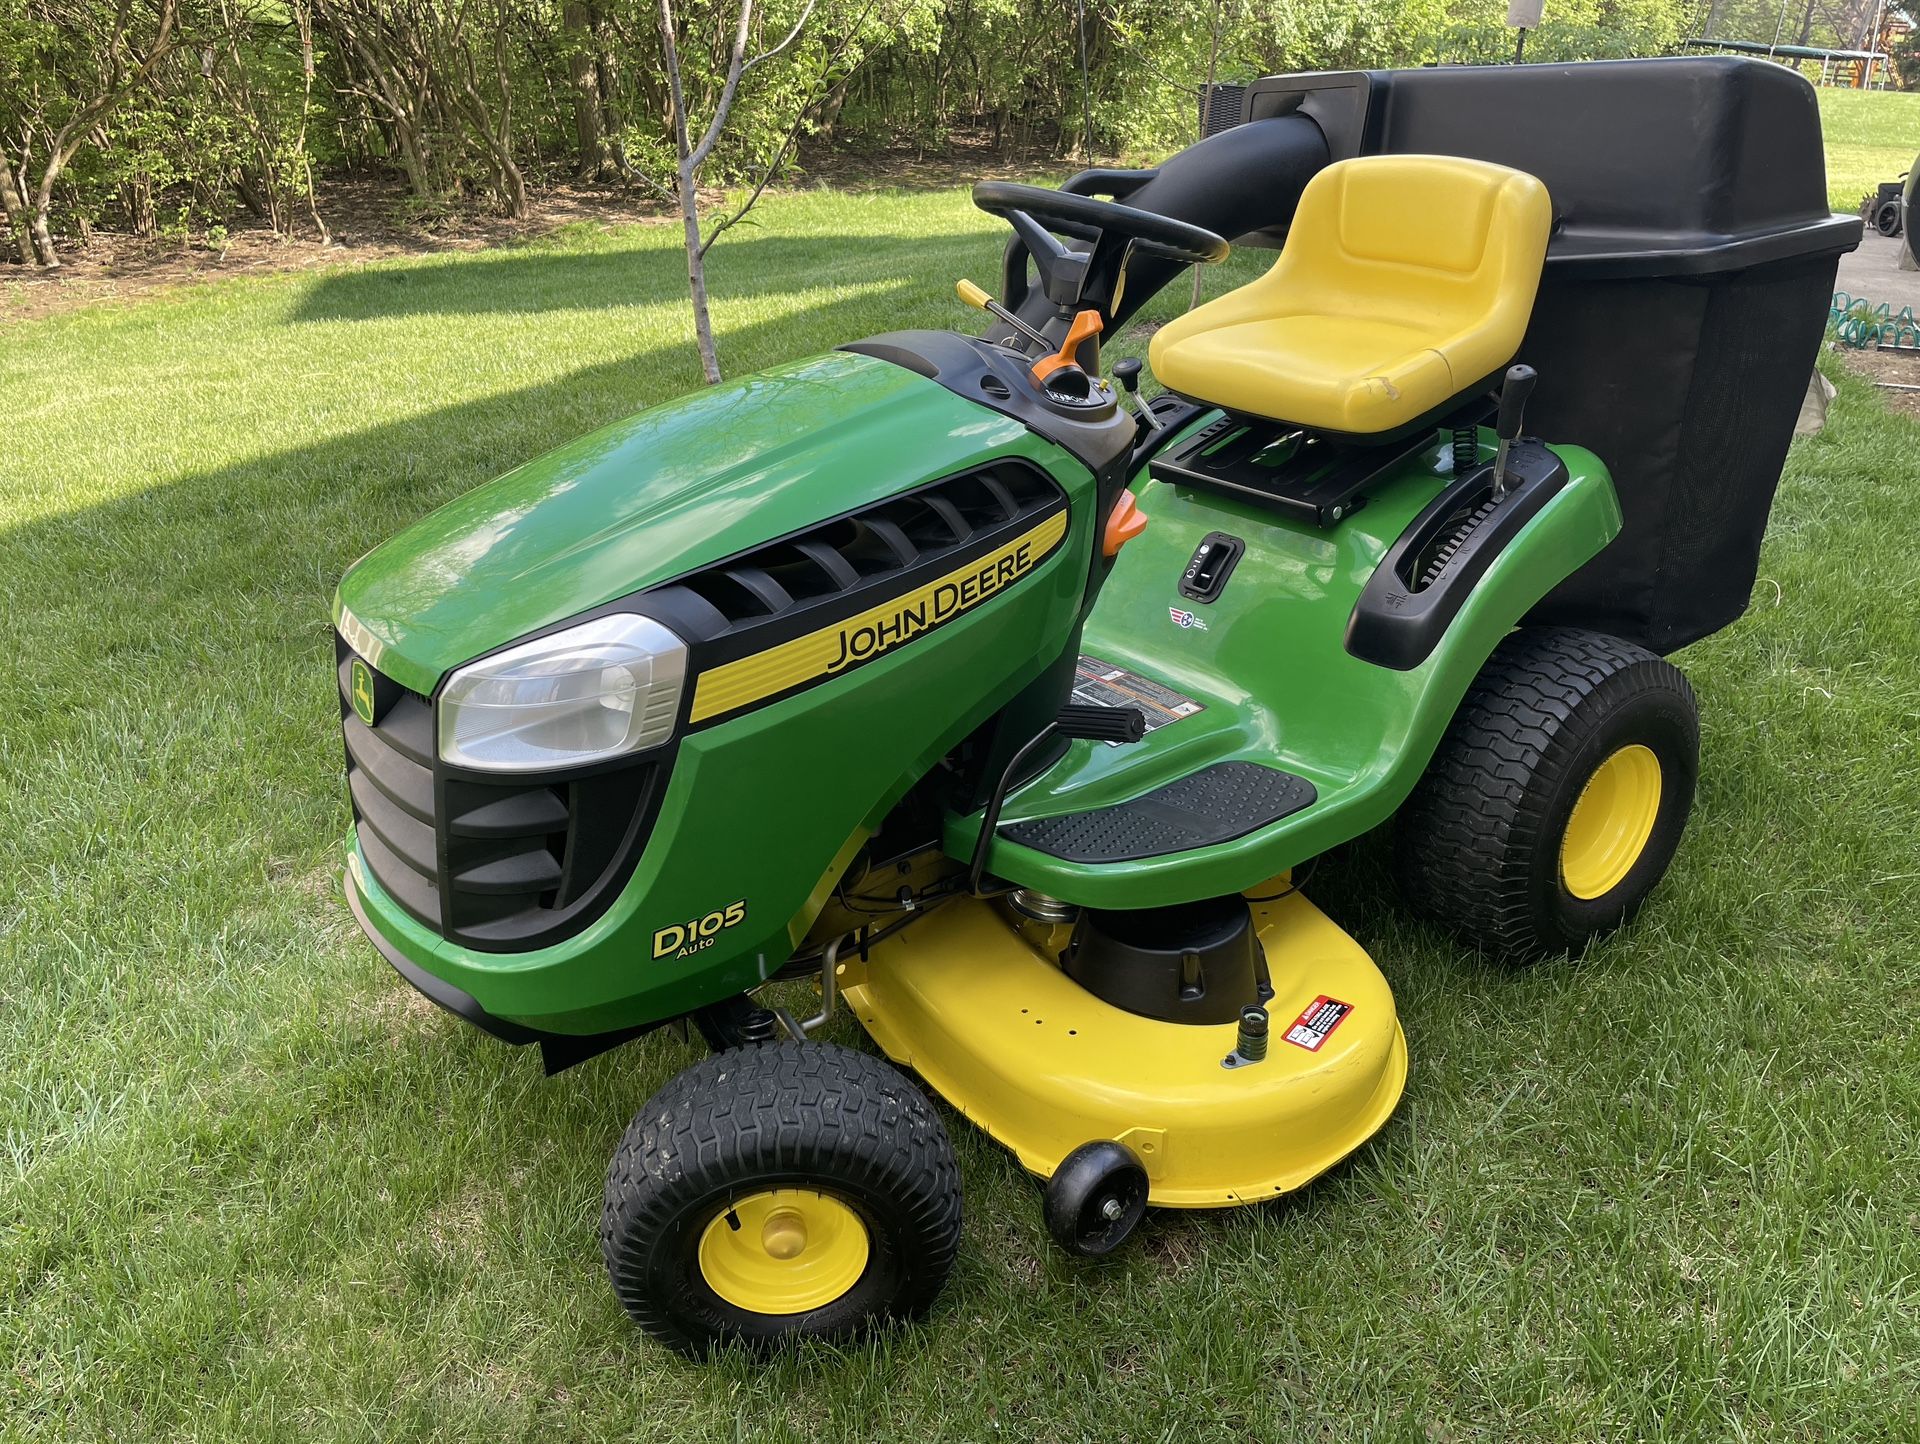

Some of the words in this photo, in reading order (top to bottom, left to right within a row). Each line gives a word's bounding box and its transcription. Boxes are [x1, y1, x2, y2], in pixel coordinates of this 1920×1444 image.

[827, 601, 926, 670] JOHN
[933, 541, 1032, 620] DEERE
[652, 899, 746, 959] D105
[675, 938, 715, 960] Auto
